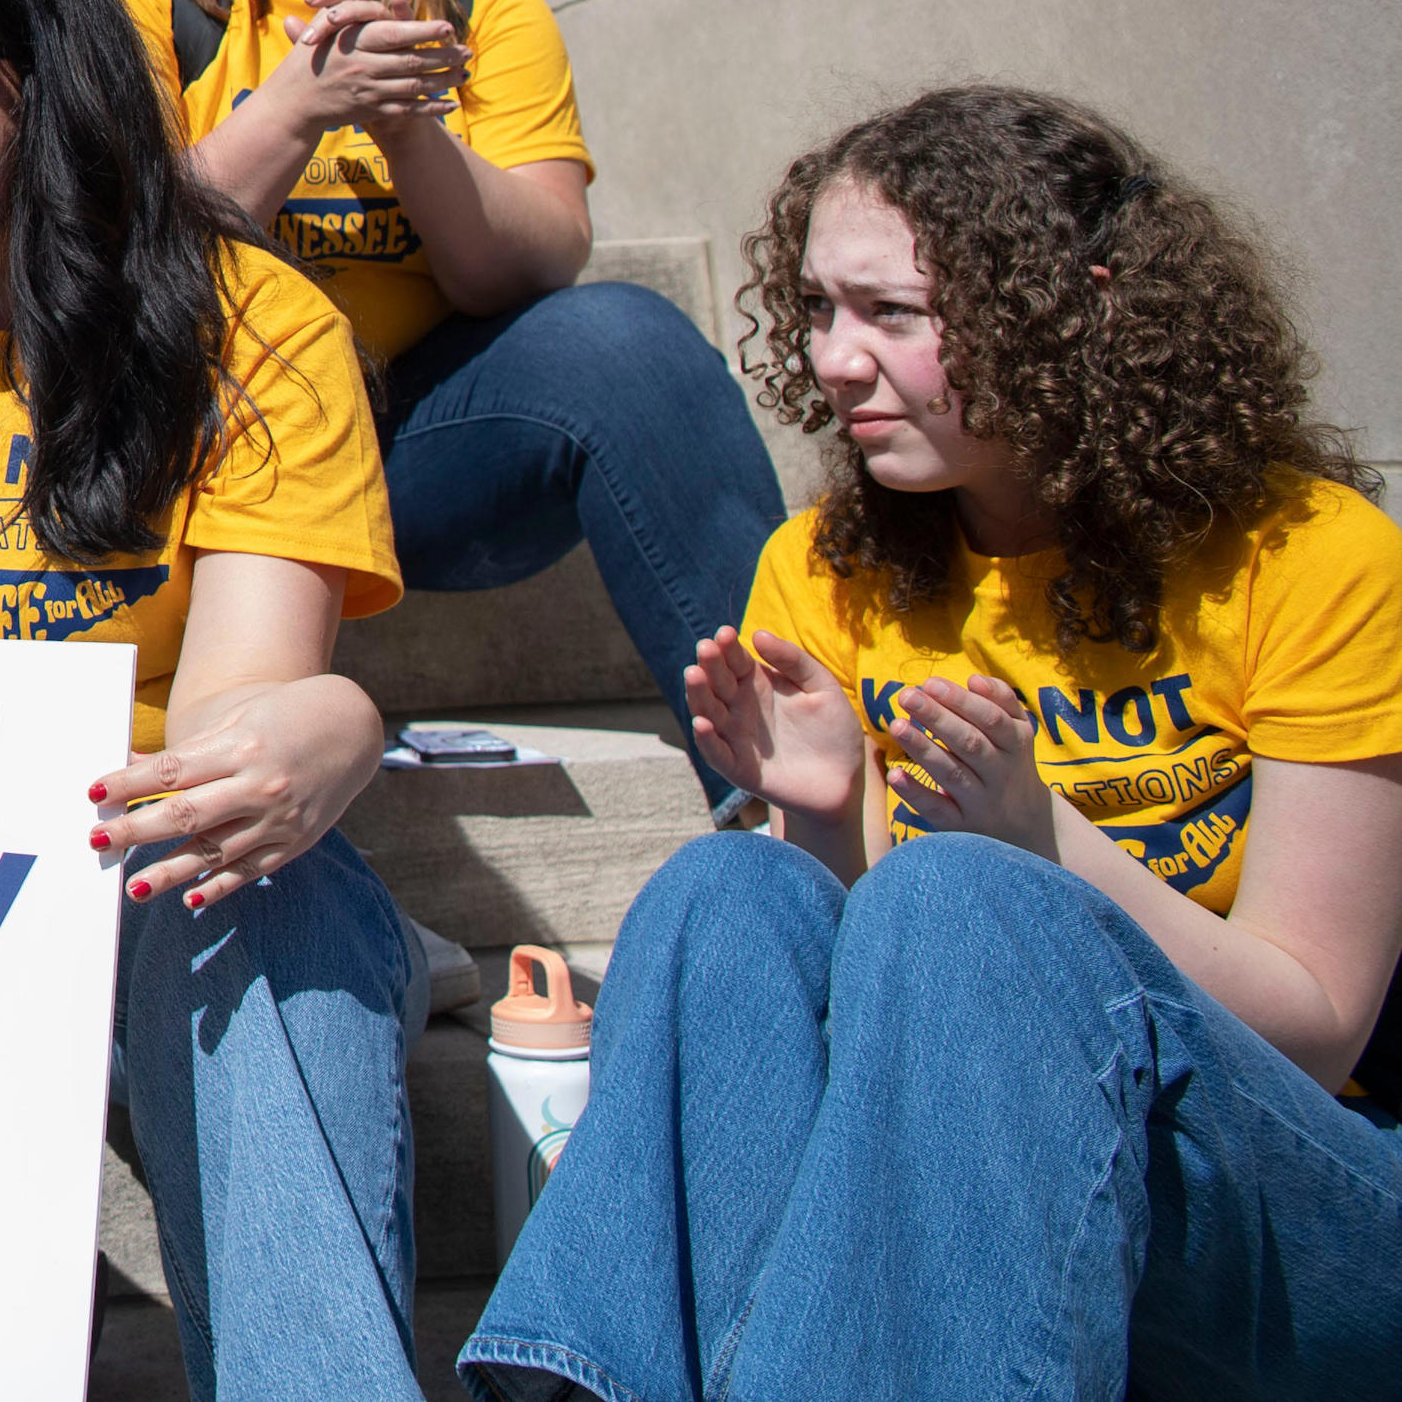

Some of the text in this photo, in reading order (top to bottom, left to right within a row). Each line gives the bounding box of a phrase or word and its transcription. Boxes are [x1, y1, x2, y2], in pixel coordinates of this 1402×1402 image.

[277, 208, 410, 257] NESSEE
[45, 599, 77, 624] for
[75, 579, 126, 620] ALL
[1038, 672, 1196, 748] NOT
[1148, 811, 1237, 880] for ALL
